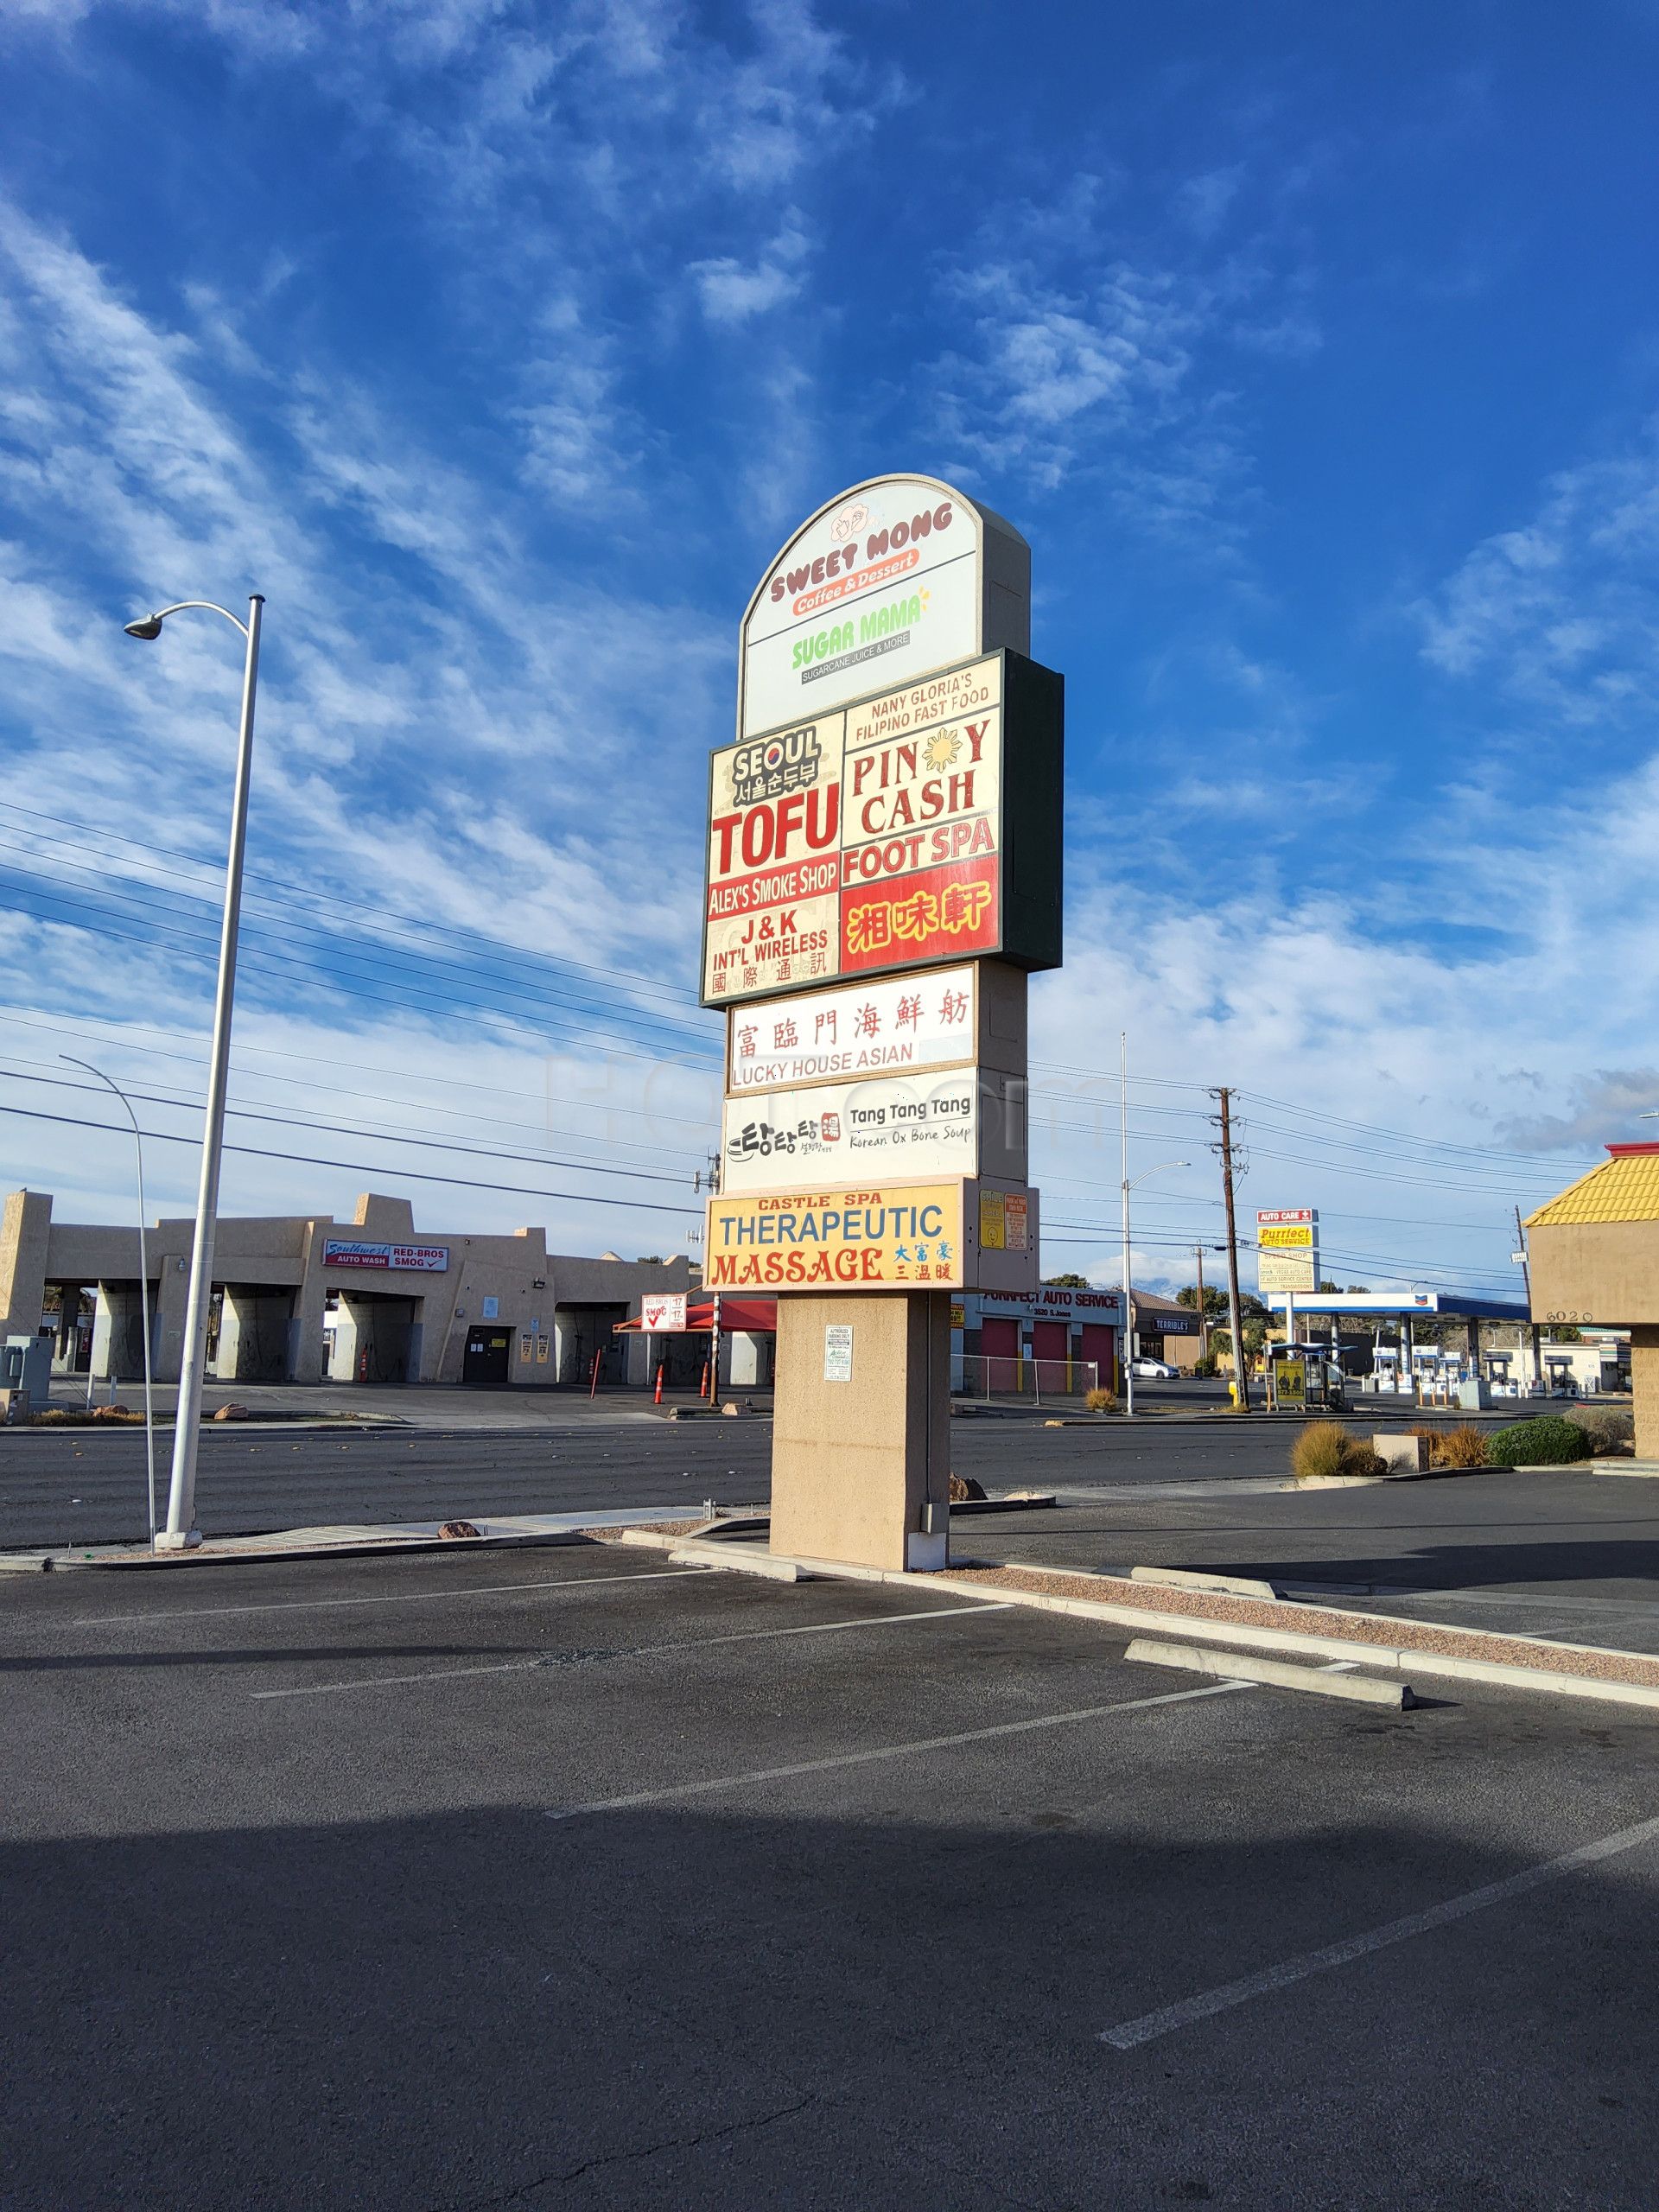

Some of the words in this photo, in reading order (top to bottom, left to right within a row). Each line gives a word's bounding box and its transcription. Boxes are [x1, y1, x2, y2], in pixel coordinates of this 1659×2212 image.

[771, 543, 858, 602] SWEET
[867, 502, 952, 561] MONG
[798, 587, 842, 613] Coffee
[845, 578, 855, 593] &
[858, 554, 914, 585] Dessert
[792, 621, 854, 670] SUGAR
[860, 594, 921, 644] MAMA
[803, 656, 850, 682] SUGARCANE
[852, 649, 874, 663] JUICE
[884, 633, 908, 651] MORE
[856, 713, 910, 741] FILIPINO
[914, 700, 948, 723] FAST
[951, 687, 988, 710] FOOD
[872, 695, 906, 719] NANY
[911, 672, 972, 706] GLORIA'S
[735, 731, 818, 781] SEOUL
[735, 761, 816, 803] 서울순두부
[861, 769, 976, 834] CASH
[713, 782, 839, 874] TOFU
[842, 834, 925, 883] FOOT
[931, 817, 995, 862] SPA
[709, 884, 749, 916] ALEX'S
[752, 872, 797, 905] SMOKE
[800, 862, 836, 893] SHOP
[741, 919, 753, 944] J
[759, 916, 775, 940] &
[780, 909, 798, 936] K
[848, 882, 990, 953] 湘味軒
[714, 948, 748, 971] INT'L
[755, 930, 828, 962] WIRELESS
[713, 952, 827, 994] 國際通訊
[737, 988, 969, 1058] 富臨門海鮮舫
[734, 1062, 788, 1085] LUCKY
[792, 1052, 852, 1077] HOUSE
[856, 1043, 912, 1067] ASIAN
[850, 1109, 886, 1125] Tang
[890, 1103, 927, 1120] Tang
[931, 1096, 970, 1116] Tang
[850, 1135, 887, 1148] Korean
[893, 1130, 906, 1143] Ox
[912, 1128, 938, 1142] Bone
[944, 1126, 971, 1143] Soup
[759, 1195, 830, 1211] CASTLE
[844, 1192, 882, 1205] SPA
[720, 1205, 943, 1245] THERAPEUTIC
[1261, 1228, 1309, 1238] Purrfect
[329, 1243, 388, 1255] Southwest
[393, 1248, 444, 1258] RED-BROS
[394, 1257, 423, 1267] SMOG
[711, 1248, 884, 1285] MASSAGE
[893, 1240, 953, 1262] 大富豪
[895, 1263, 953, 1281] 三溫暖
[645, 1306, 666, 1316] SMOG
[1043, 1290, 1071, 1306] AUTO
[1075, 1293, 1118, 1309] SERVICE
[1547, 1311, 1592, 1322] 6020
[1156, 1320, 1188, 1331] TERRIBLE'S
